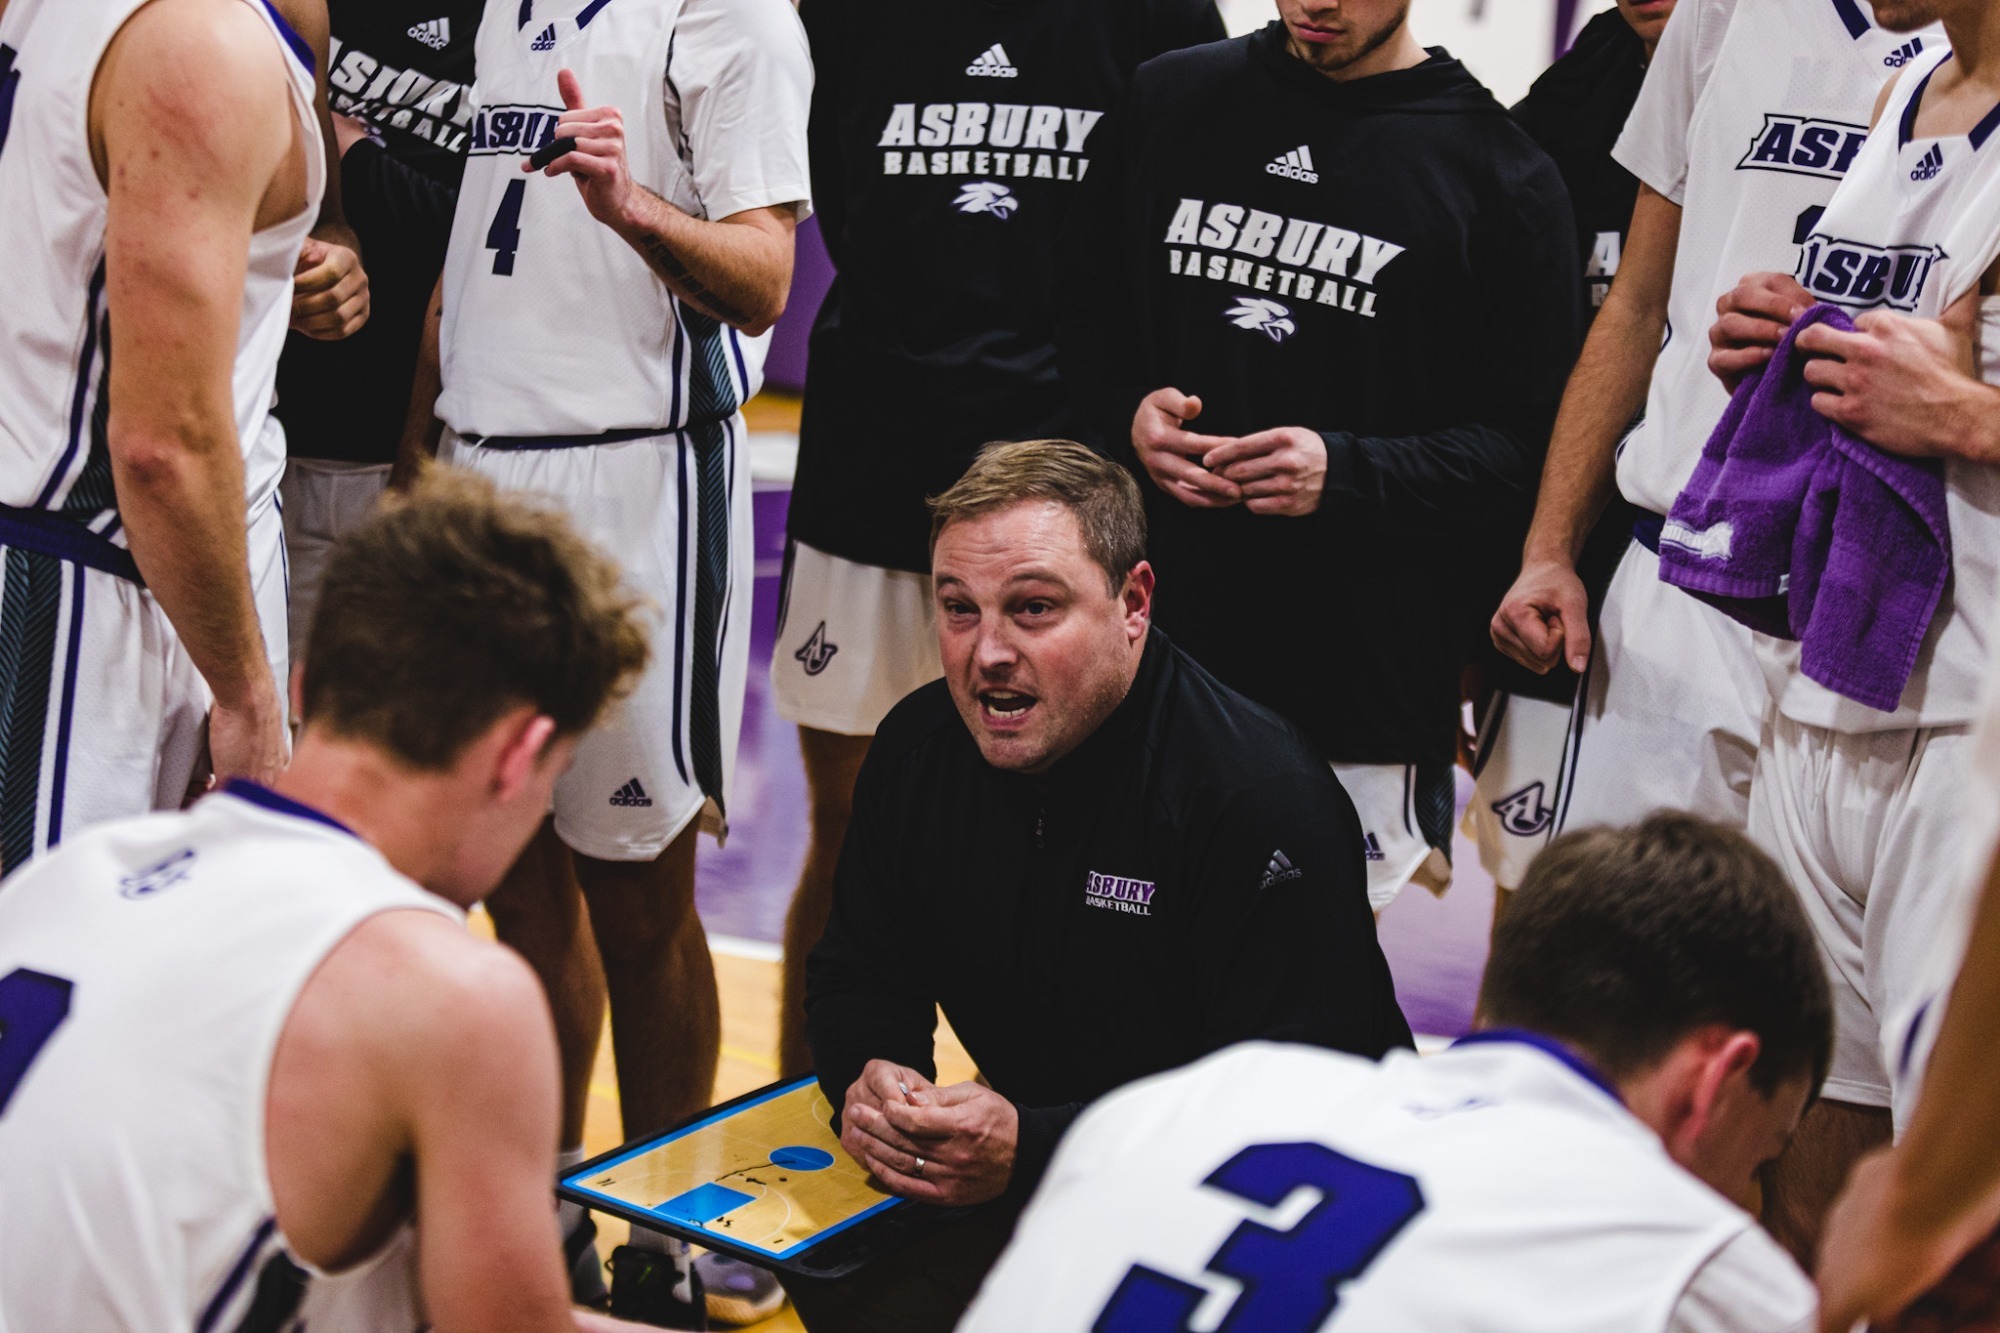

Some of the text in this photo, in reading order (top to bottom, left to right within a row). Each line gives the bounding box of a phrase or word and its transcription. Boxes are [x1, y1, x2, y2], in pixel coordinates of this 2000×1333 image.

[407, 26, 445, 50] adid
[530, 40, 556, 51] adida
[966, 65, 1018, 78] adidas
[470, 111, 560, 150] ASBU
[877, 102, 1104, 153] ASBURY
[1751, 122, 1868, 173] ASB
[1265, 162, 1319, 184] adidas
[1910, 166, 1941, 181] adid
[486, 179, 526, 276] 4
[1163, 198, 1406, 285] ASBURY
[1169, 249, 1378, 318] BASKETBALL
[609, 796, 652, 807] adidas
[1086, 870, 1156, 905] ASBURY
[1259, 868, 1303, 890] adidas
[1086, 895, 1152, 915] BASKETBALL
[1090, 1141, 1429, 1333] 3
